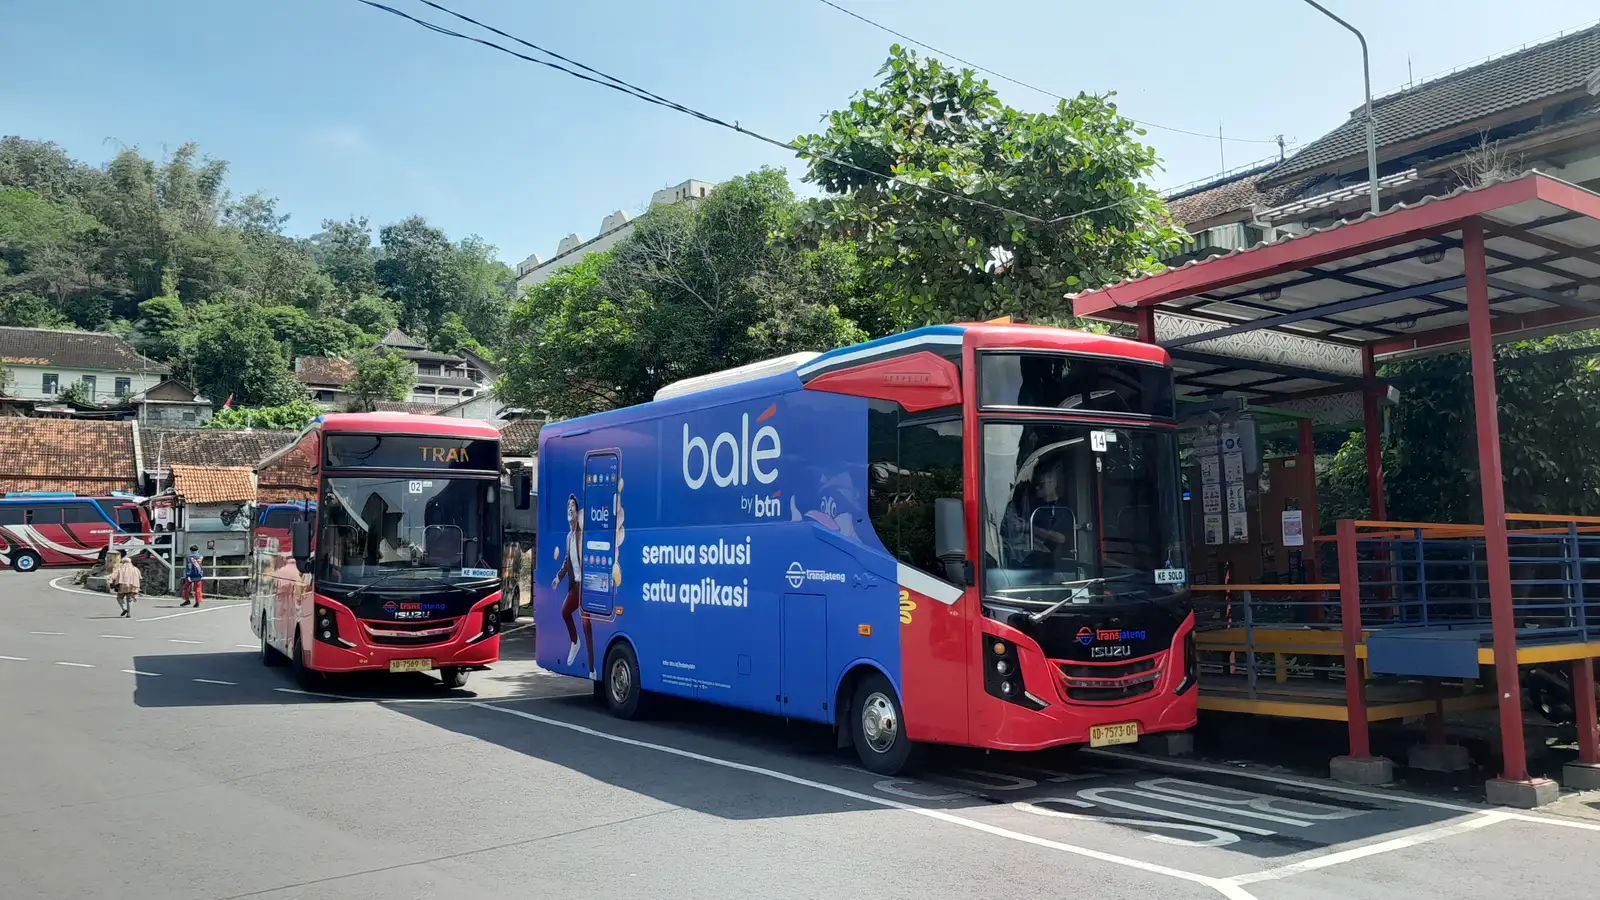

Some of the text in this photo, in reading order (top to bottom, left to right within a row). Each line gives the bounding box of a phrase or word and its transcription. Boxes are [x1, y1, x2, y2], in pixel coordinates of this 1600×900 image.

[1093, 434, 1105, 449] 14
[410, 482, 421, 492] 02
[741, 495, 753, 513] by
[642, 536, 751, 565] semua solusi
[806, 569, 846, 583] transjateng
[1157, 571, 1183, 581] KE SOLO
[642, 576, 748, 613] satu aplikasi
[399, 602, 446, 611] transjateng
[394, 611, 431, 619] ISUZU
[1096, 629, 1146, 641] transjateng
[1091, 645, 1131, 658] ISUZU
[1012, 777, 1374, 848] BUS
